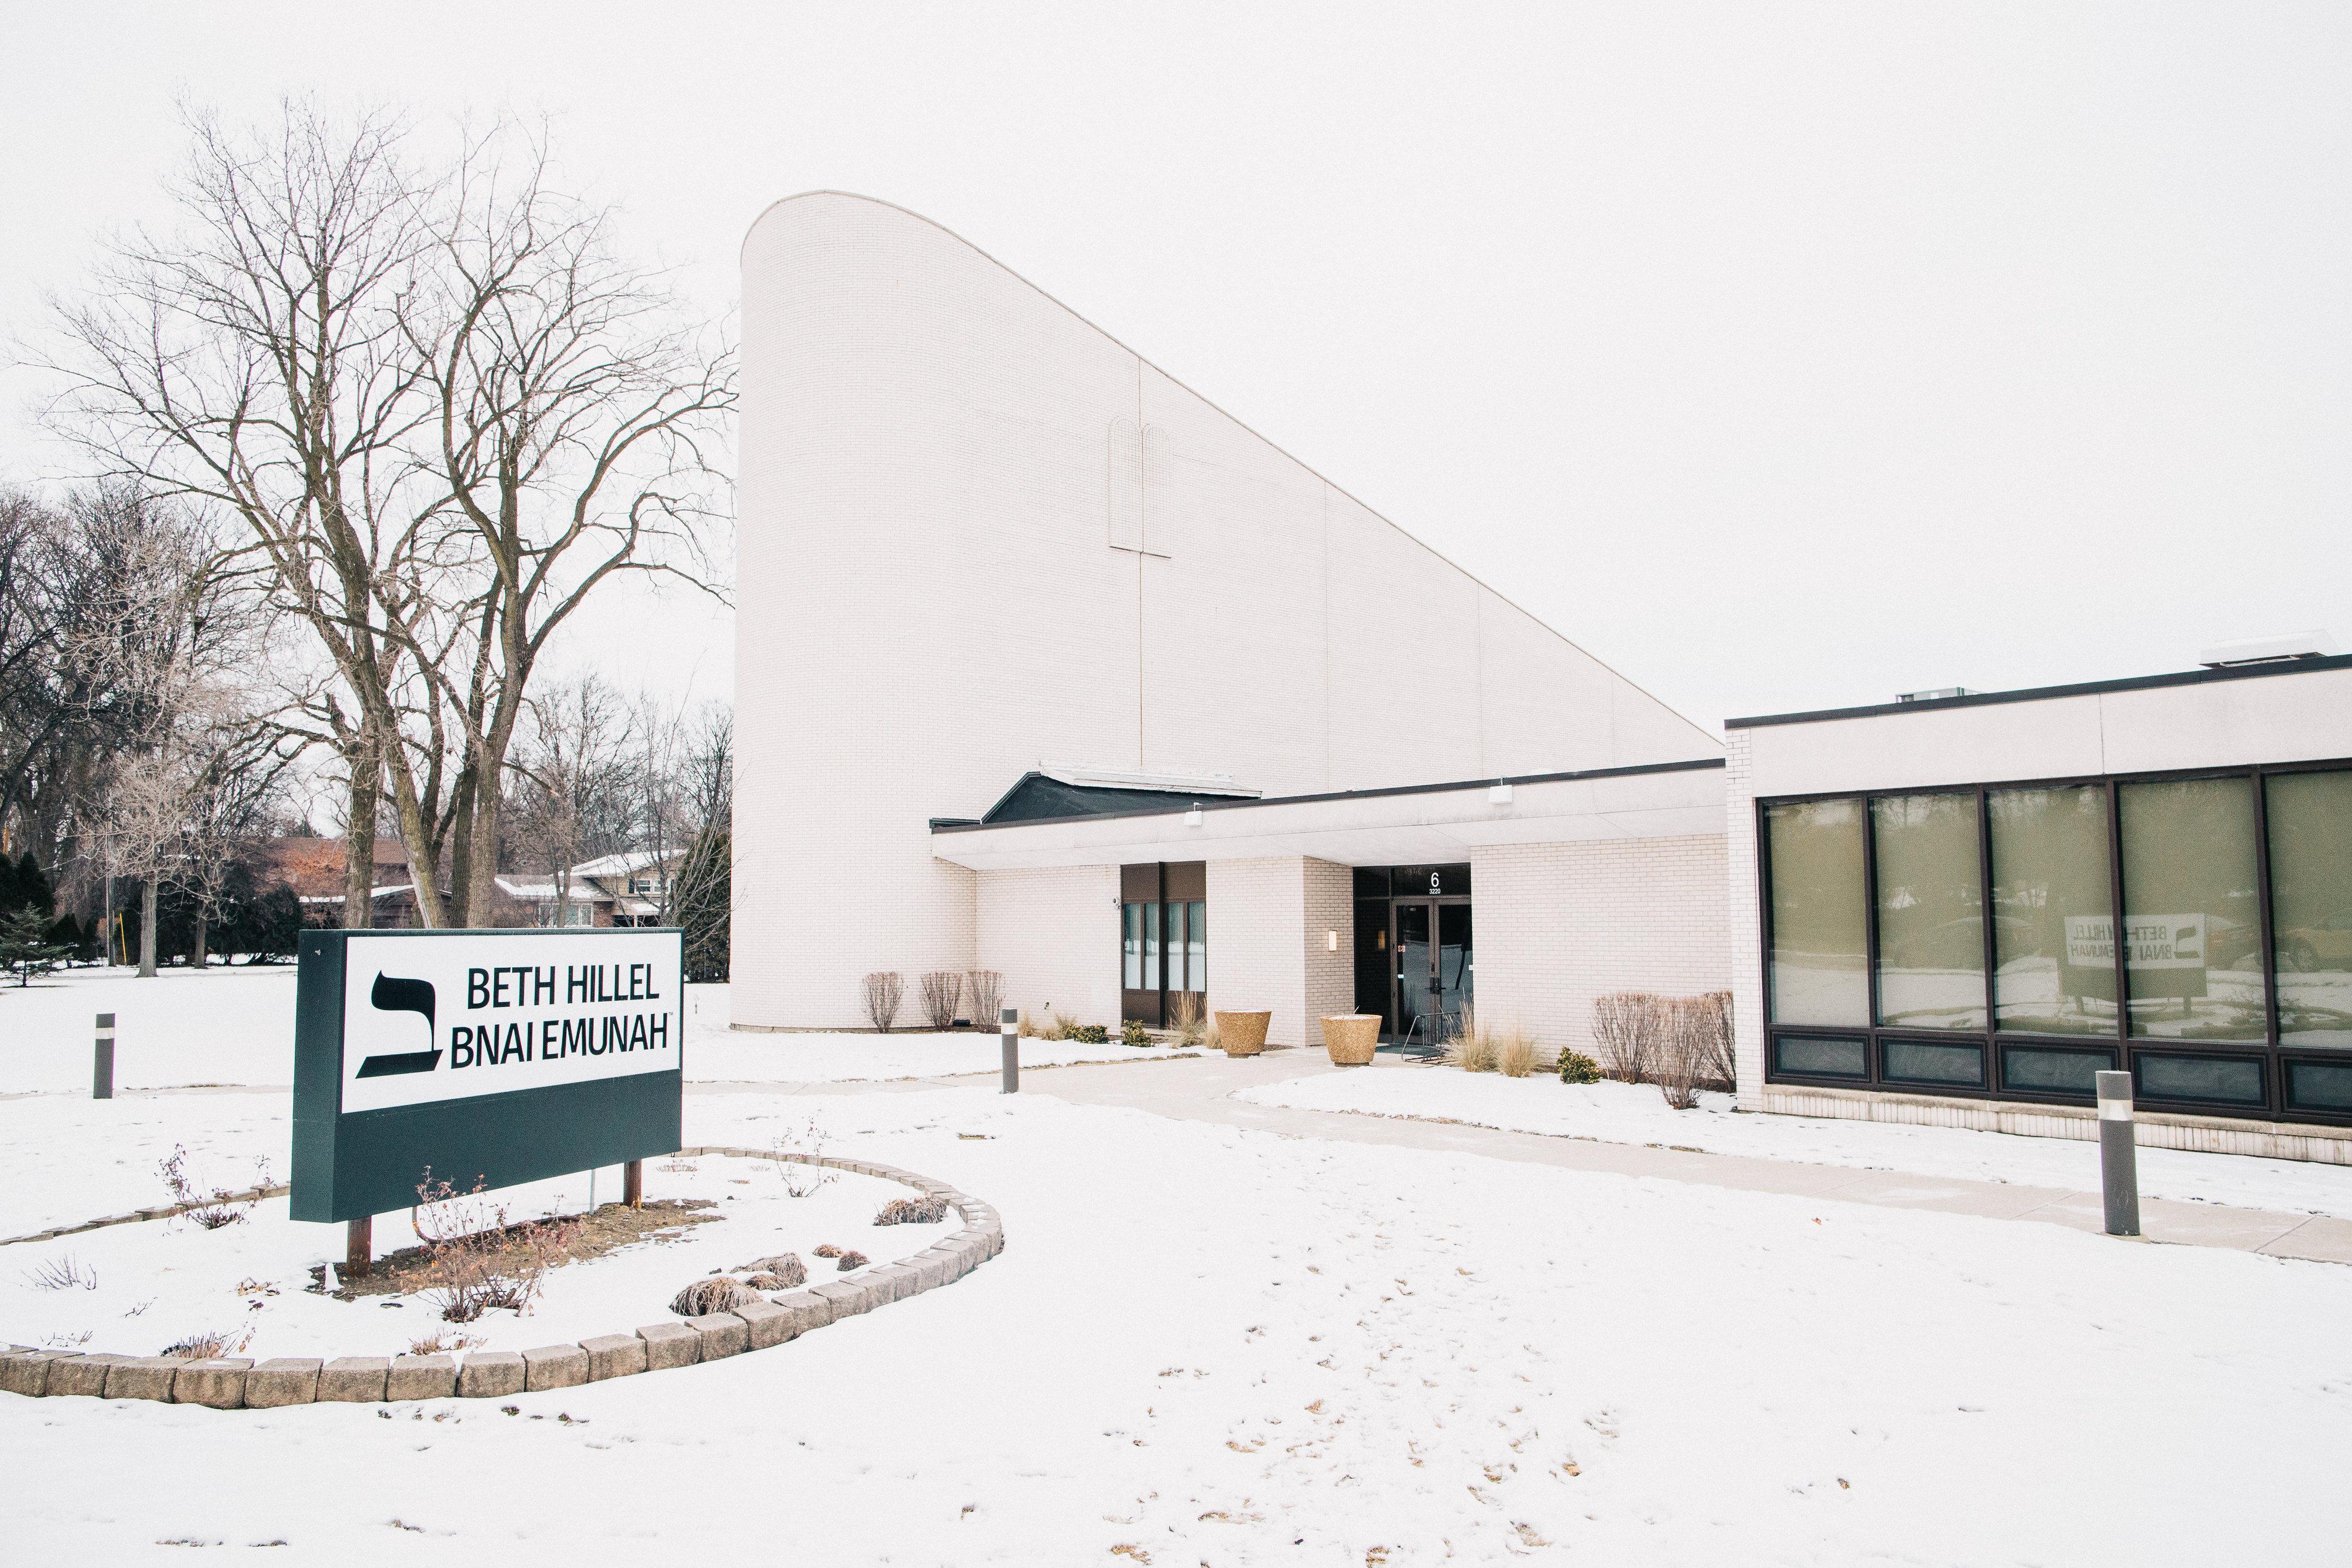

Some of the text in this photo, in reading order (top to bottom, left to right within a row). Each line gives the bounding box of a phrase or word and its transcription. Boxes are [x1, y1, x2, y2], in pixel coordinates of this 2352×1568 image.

[1431, 872, 1439, 888] 6
[467, 964, 660, 1009] BETH HILLEL
[451, 1021, 533, 1069] BNAI
[542, 1012, 667, 1060] EMUNAH
